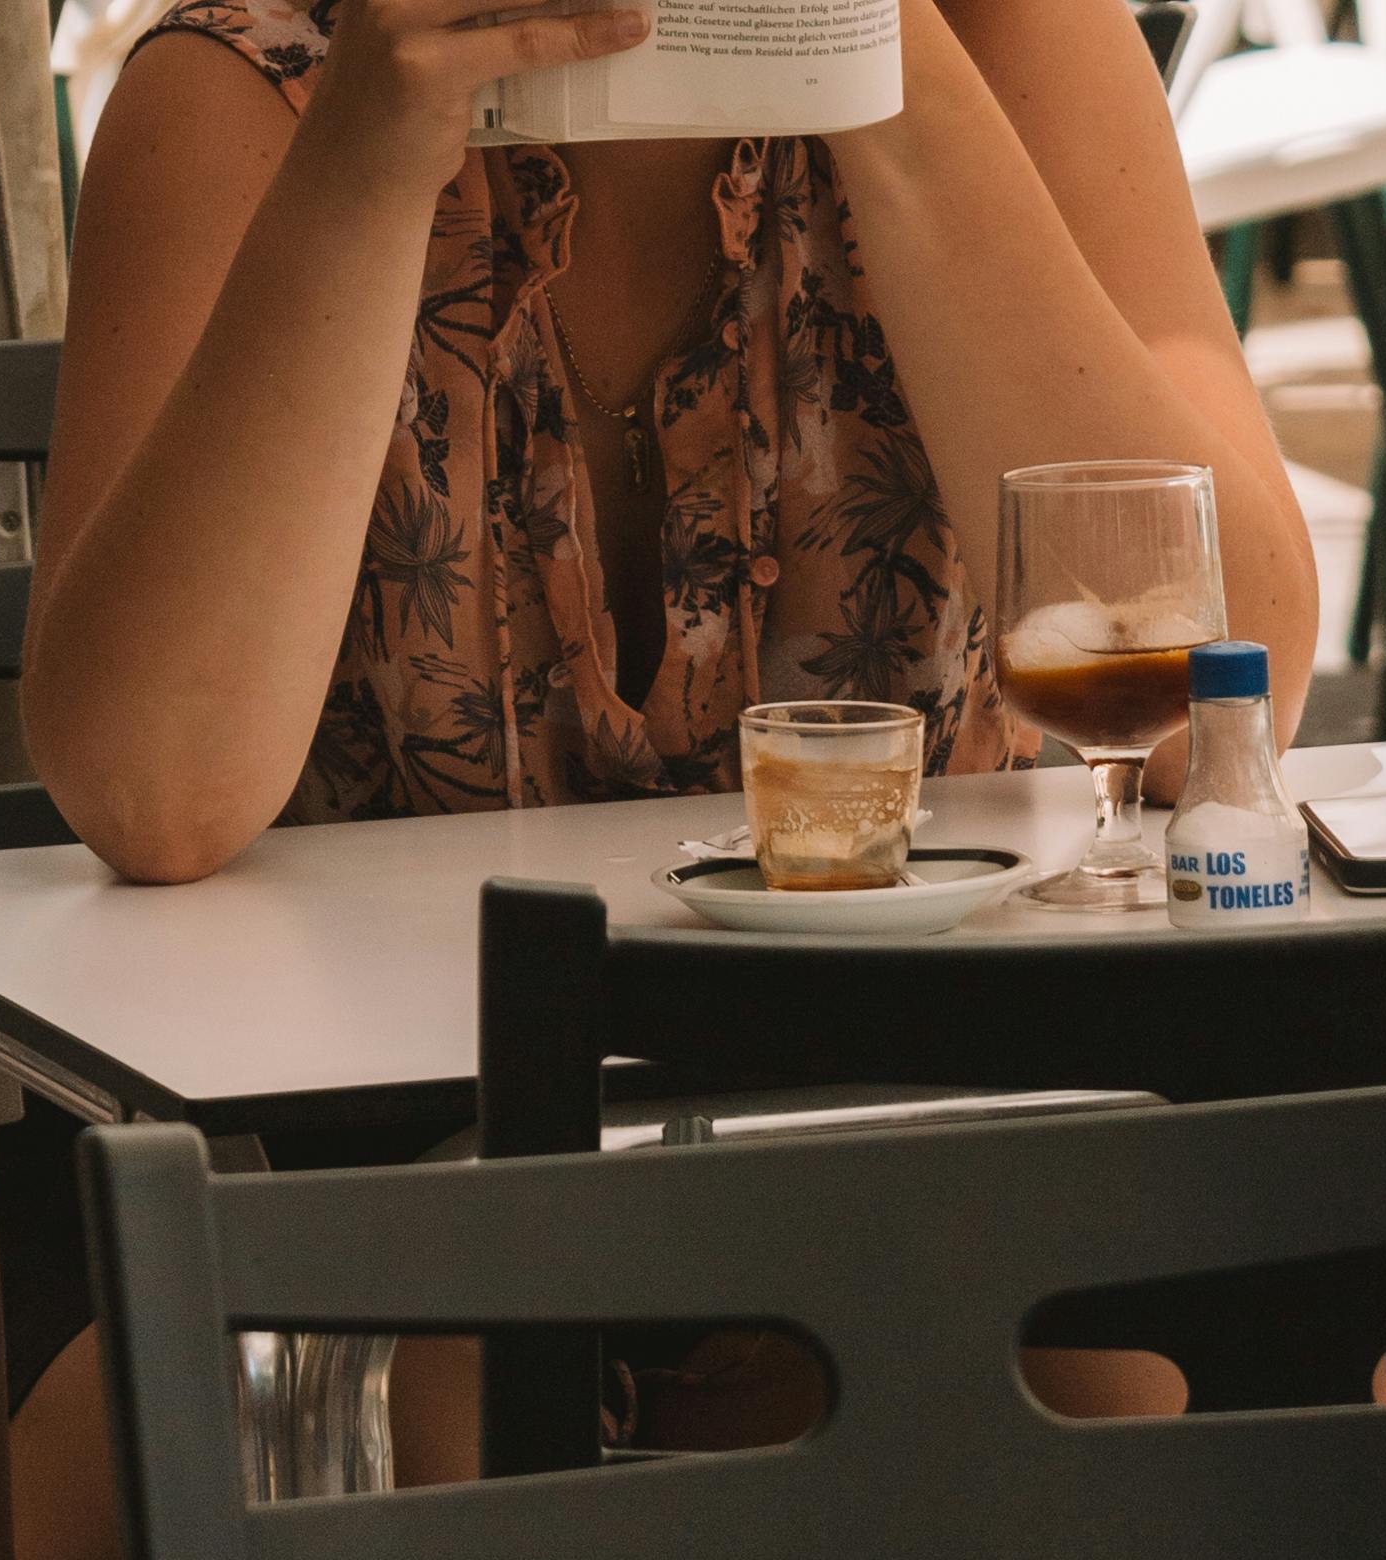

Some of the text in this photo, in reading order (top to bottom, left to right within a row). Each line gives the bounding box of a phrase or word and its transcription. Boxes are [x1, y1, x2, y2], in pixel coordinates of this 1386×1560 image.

[658, 0, 795, 14] Chance auf wirtschaftlichen
[693, 16, 731, 26] Gesetze
[732, 18, 752, 27] und
[754, 19, 793, 30] gläserne
[657, 27, 769, 42] Karten von vorneherein
[657, 43, 793, 56] seinen Weg aus dem Reisfeld
[1171, 852, 1246, 876] BAR LOS
[1206, 881, 1294, 910] TONELES
